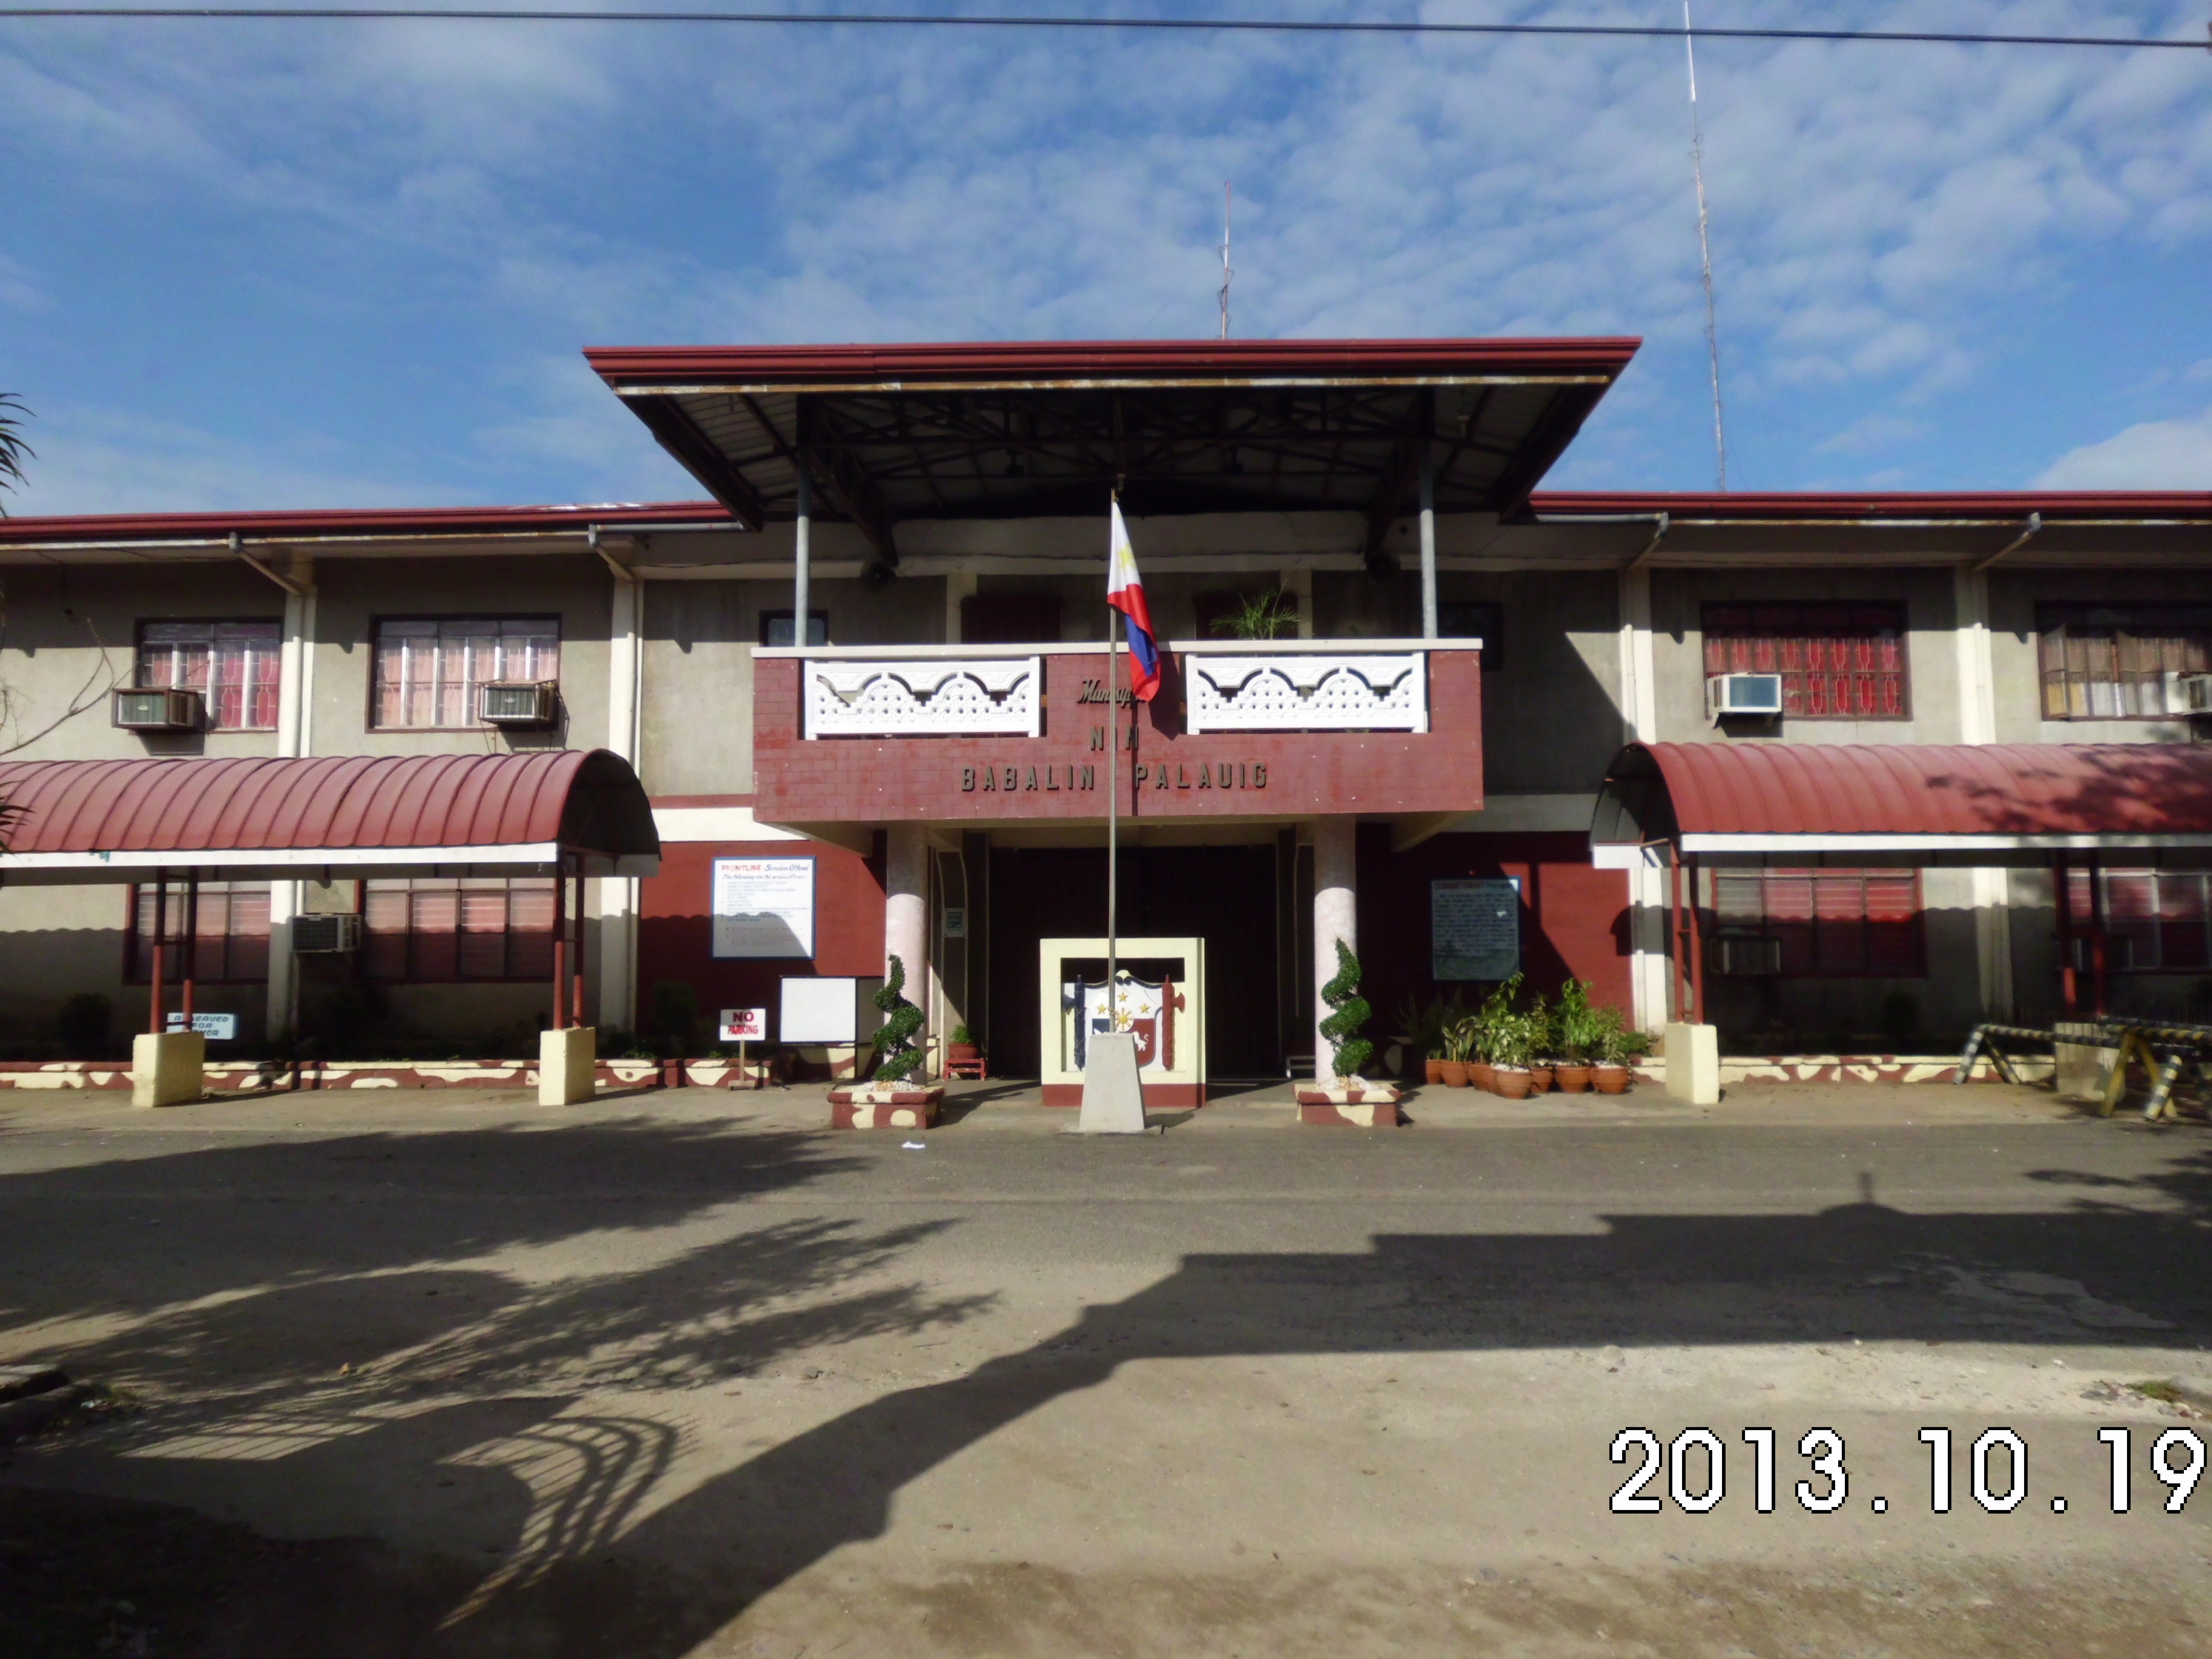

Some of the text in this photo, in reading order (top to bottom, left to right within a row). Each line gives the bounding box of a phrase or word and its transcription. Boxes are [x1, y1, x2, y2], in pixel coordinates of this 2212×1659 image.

[1077, 679, 1146, 709] Munsip
[1091, 725, 1139, 751] NN
[961, 762, 1268, 792] BABALIN PALAUIG
[728, 1025, 758, 1035] PARKING
[733, 1012, 754, 1022] NO
